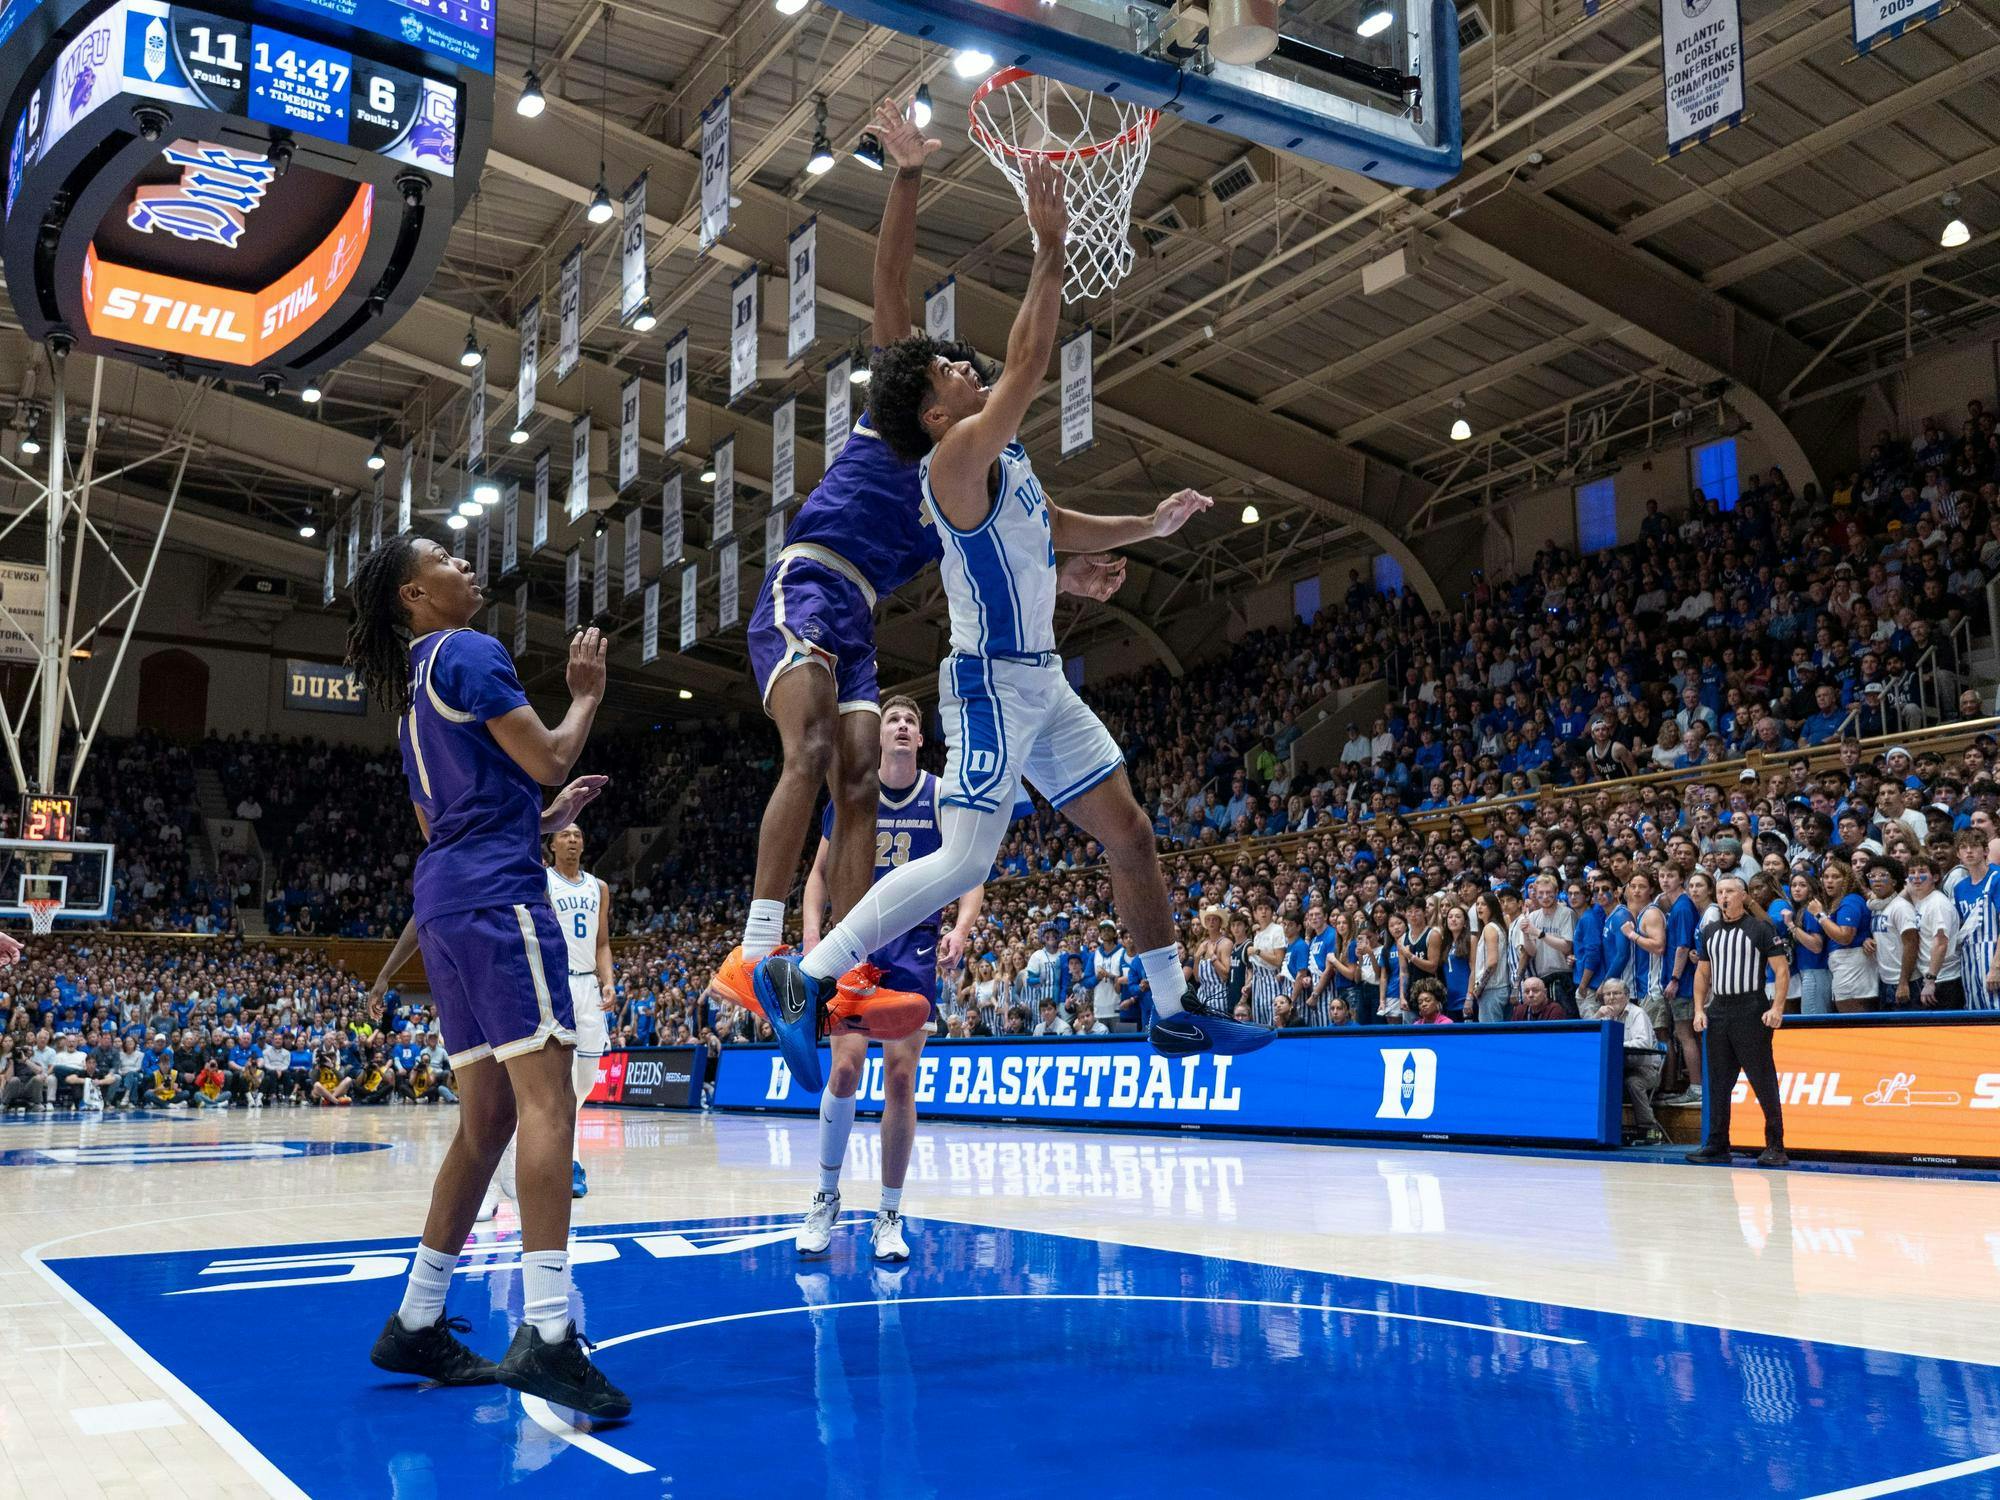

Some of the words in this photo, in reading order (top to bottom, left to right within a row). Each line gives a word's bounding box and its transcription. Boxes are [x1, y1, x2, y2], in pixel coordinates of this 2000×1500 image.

[438, 1, 448, 13] 4
[190, 27, 243, 72] 11
[1675, 19, 1725, 55] ATLANTIC
[61, 28, 111, 99] WCU
[1667, 42, 1737, 88] CONFERENCE
[1684, 38, 1718, 65] COAST
[193, 69, 232, 88] Fouls:
[232, 79, 241, 89] 3
[254, 42, 350, 94] 14:47
[1670, 60, 1734, 101] CHAMPIONS
[255, 86, 265, 96] 4
[269, 89, 331, 115] TIMEOUTS
[273, 78, 295, 93] 1ST
[296, 86, 329, 102] HALF
[369, 76, 396, 114] 6
[29, 88, 41, 138] 6
[285, 105, 315, 122] POSS
[335, 108, 344, 118] 4
[357, 109, 391, 128] Fouls:
[391, 119, 400, 130] 3
[1690, 101, 1719, 126] 2006
[705, 142, 726, 187] 24
[625, 222, 643, 257] 43
[101, 287, 247, 343] STIHL
[260, 276, 319, 341] STIHL
[561, 291, 577, 323] 44
[291, 674, 360, 702] DUKE
[408, 703, 433, 800] 1
[31, 799, 72, 816] 14:47
[29, 813, 66, 840] 21
[874, 831, 912, 867] 23
[556, 896, 599, 914] DUKE
[574, 913, 587, 939] 6
[625, 1061, 663, 1086] REEDS
[854, 1056, 940, 1102] DUE
[944, 1053, 1241, 1112] BASKETBALL
[1912, 1156, 1958, 1164] DAKTRONICS
